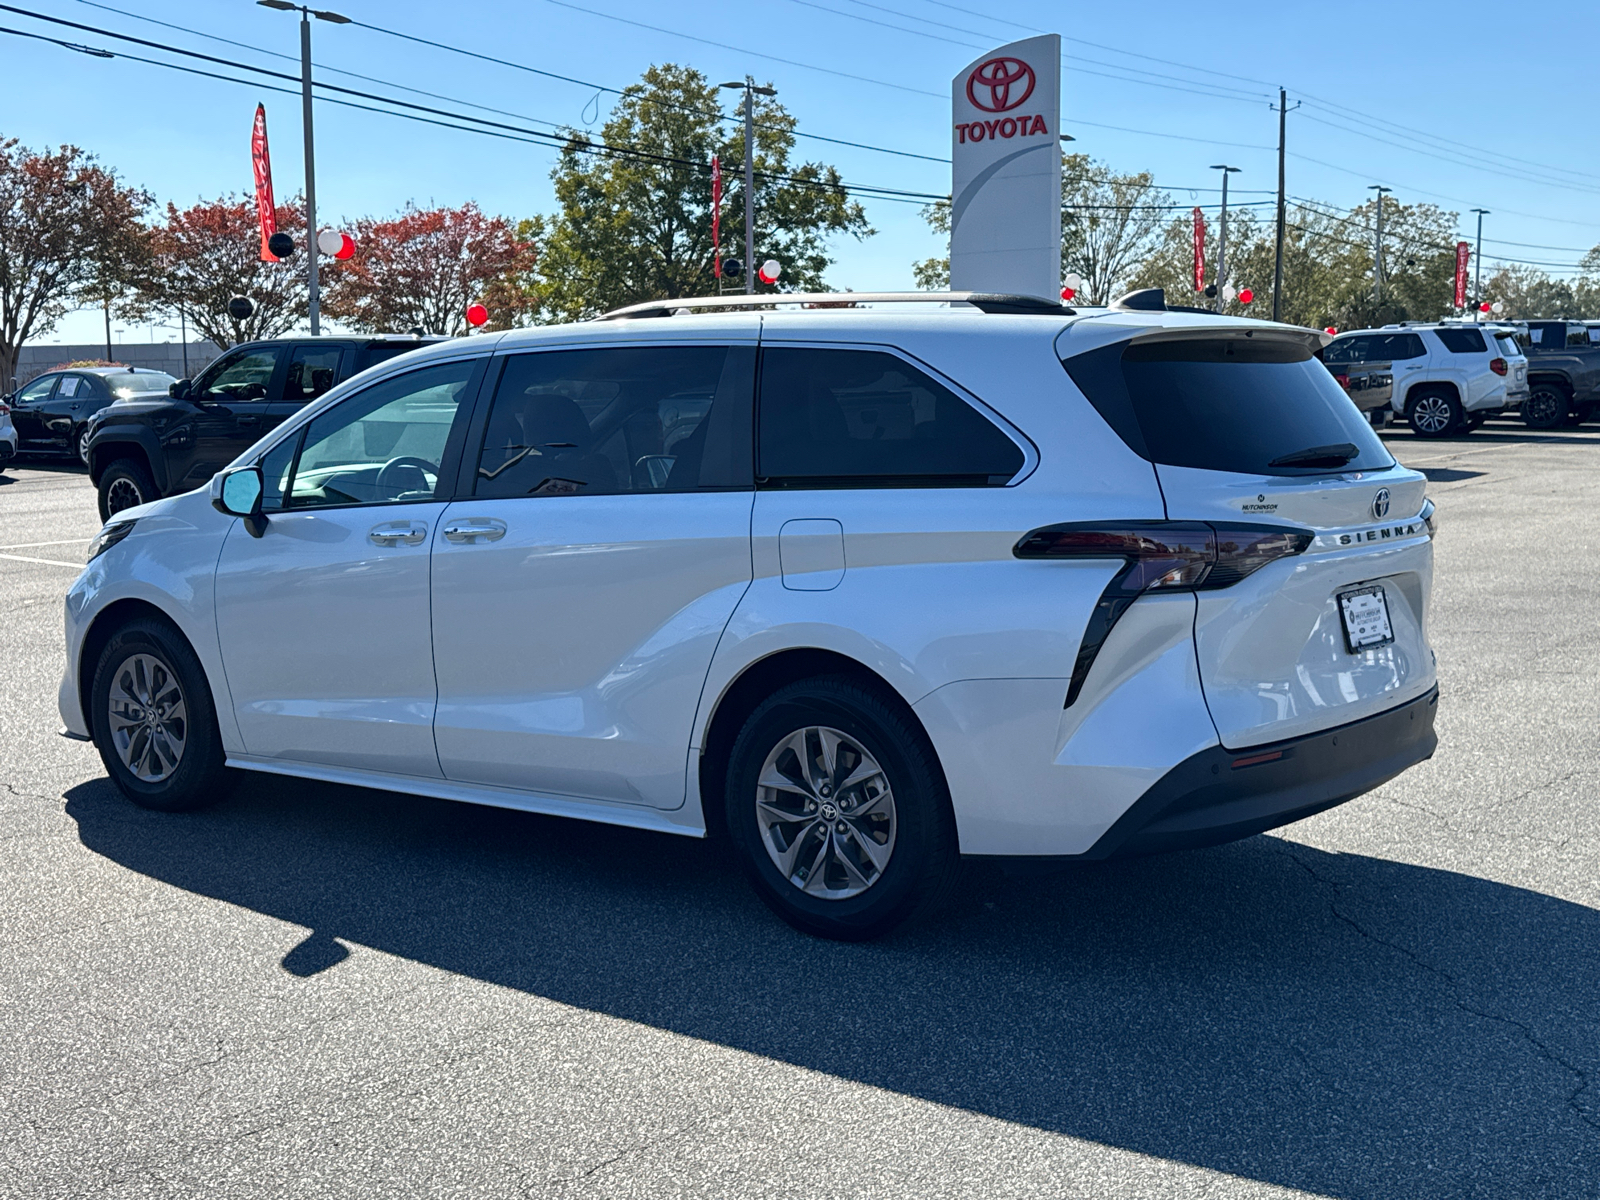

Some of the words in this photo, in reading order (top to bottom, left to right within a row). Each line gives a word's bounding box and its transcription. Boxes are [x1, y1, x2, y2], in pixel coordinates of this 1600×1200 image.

[955, 114, 1048, 144] TOYOTA
[1457, 257, 1465, 305] TOYOTA
[1241, 503, 1278, 511] HUTCHINSON
[1339, 525, 1415, 545] SIENNA
